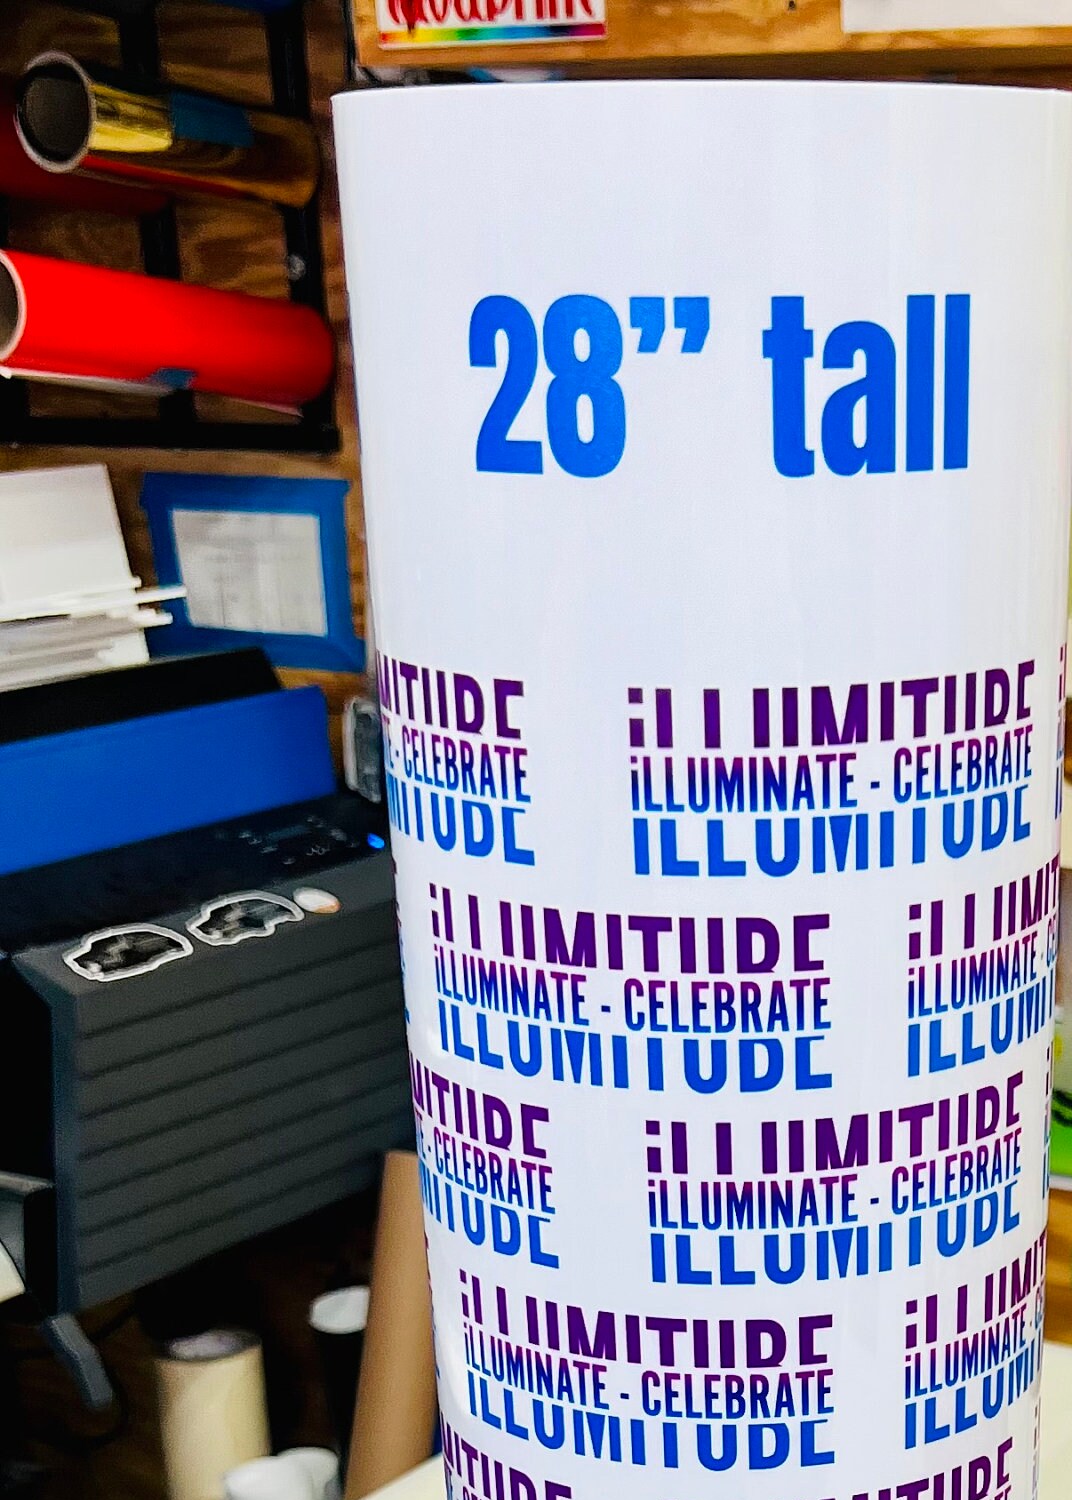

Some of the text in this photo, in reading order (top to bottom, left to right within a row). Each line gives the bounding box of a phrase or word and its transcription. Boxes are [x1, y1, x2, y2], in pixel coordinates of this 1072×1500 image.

[762, 294, 971, 478] tall
[402, 724, 532, 803] CELEBRATE
[894, 724, 1033, 801] CELEBRATE
[624, 978, 831, 1032] CELEBRATE
[434, 1127, 555, 1214] CELEBRATE
[890, 1127, 1023, 1215] CELEBRATE
[641, 1369, 834, 1419] CELEBRATE
